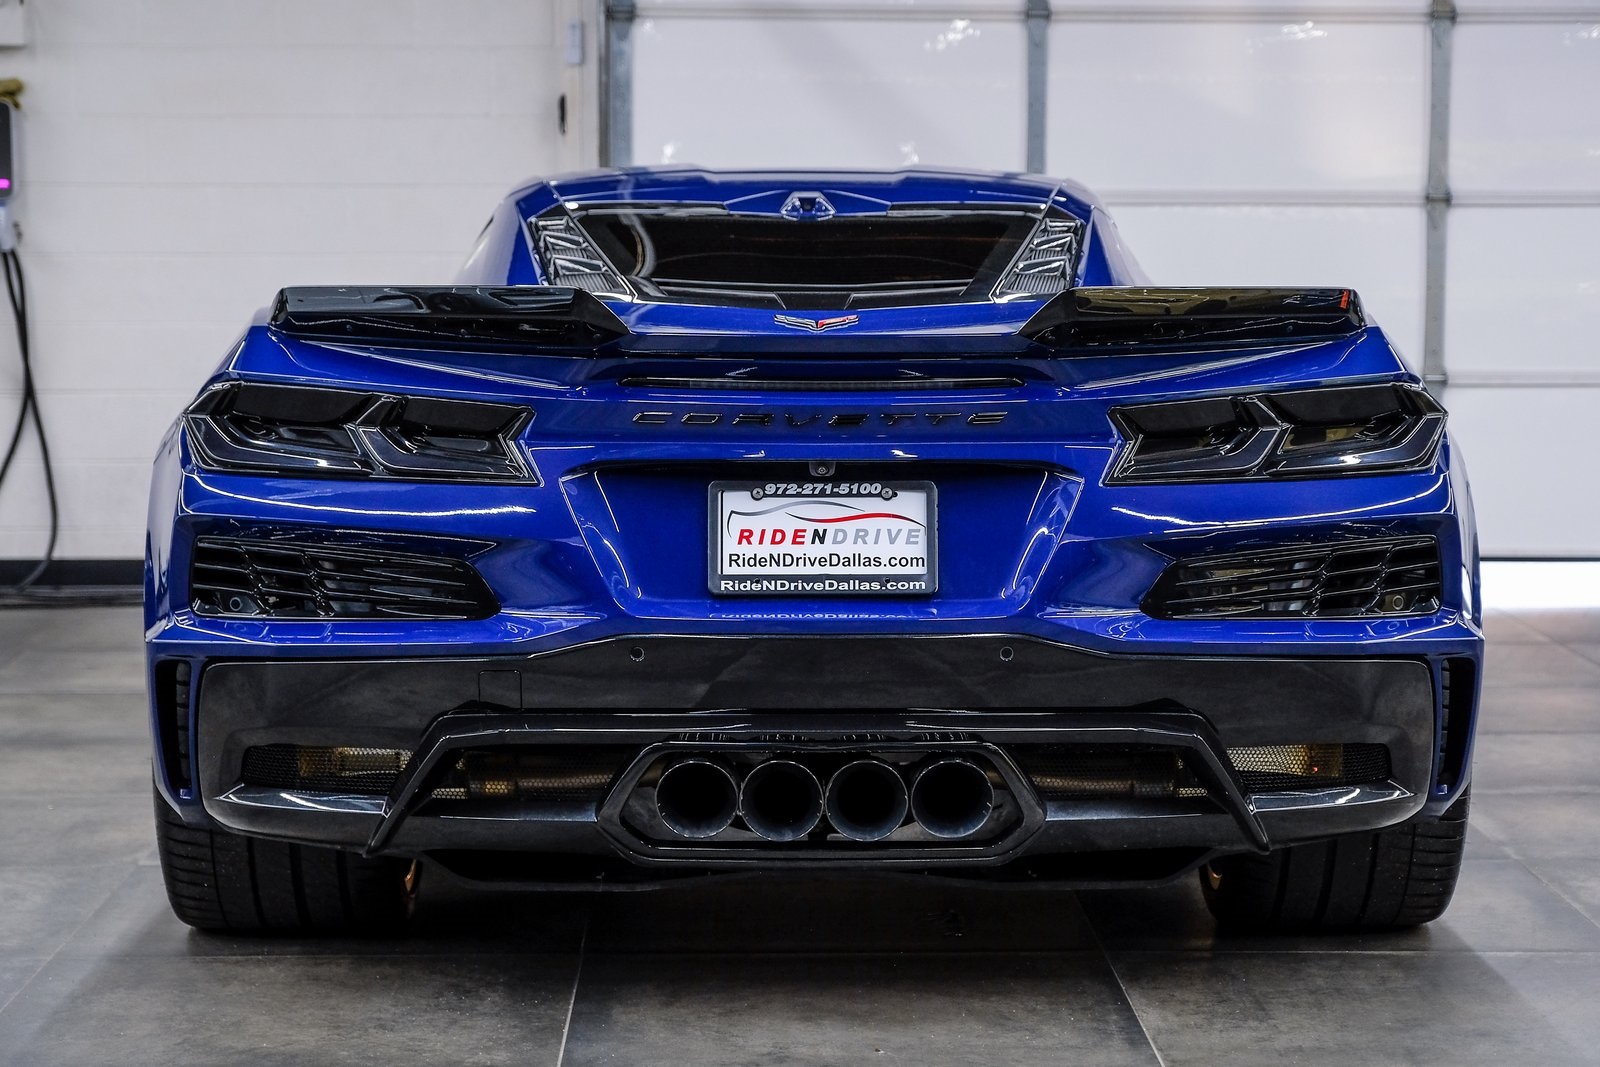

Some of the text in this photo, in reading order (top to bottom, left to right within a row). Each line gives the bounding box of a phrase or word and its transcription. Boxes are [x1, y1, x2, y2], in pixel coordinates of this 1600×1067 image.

[631, 411, 1009, 426] CORVETTE
[764, 483, 882, 495] 972-271-5100
[737, 528, 921, 545] RIDENDRIVE
[728, 553, 925, 568] RideNDriveDallas.com
[720, 579, 926, 591] RideNDriveDallas.com
